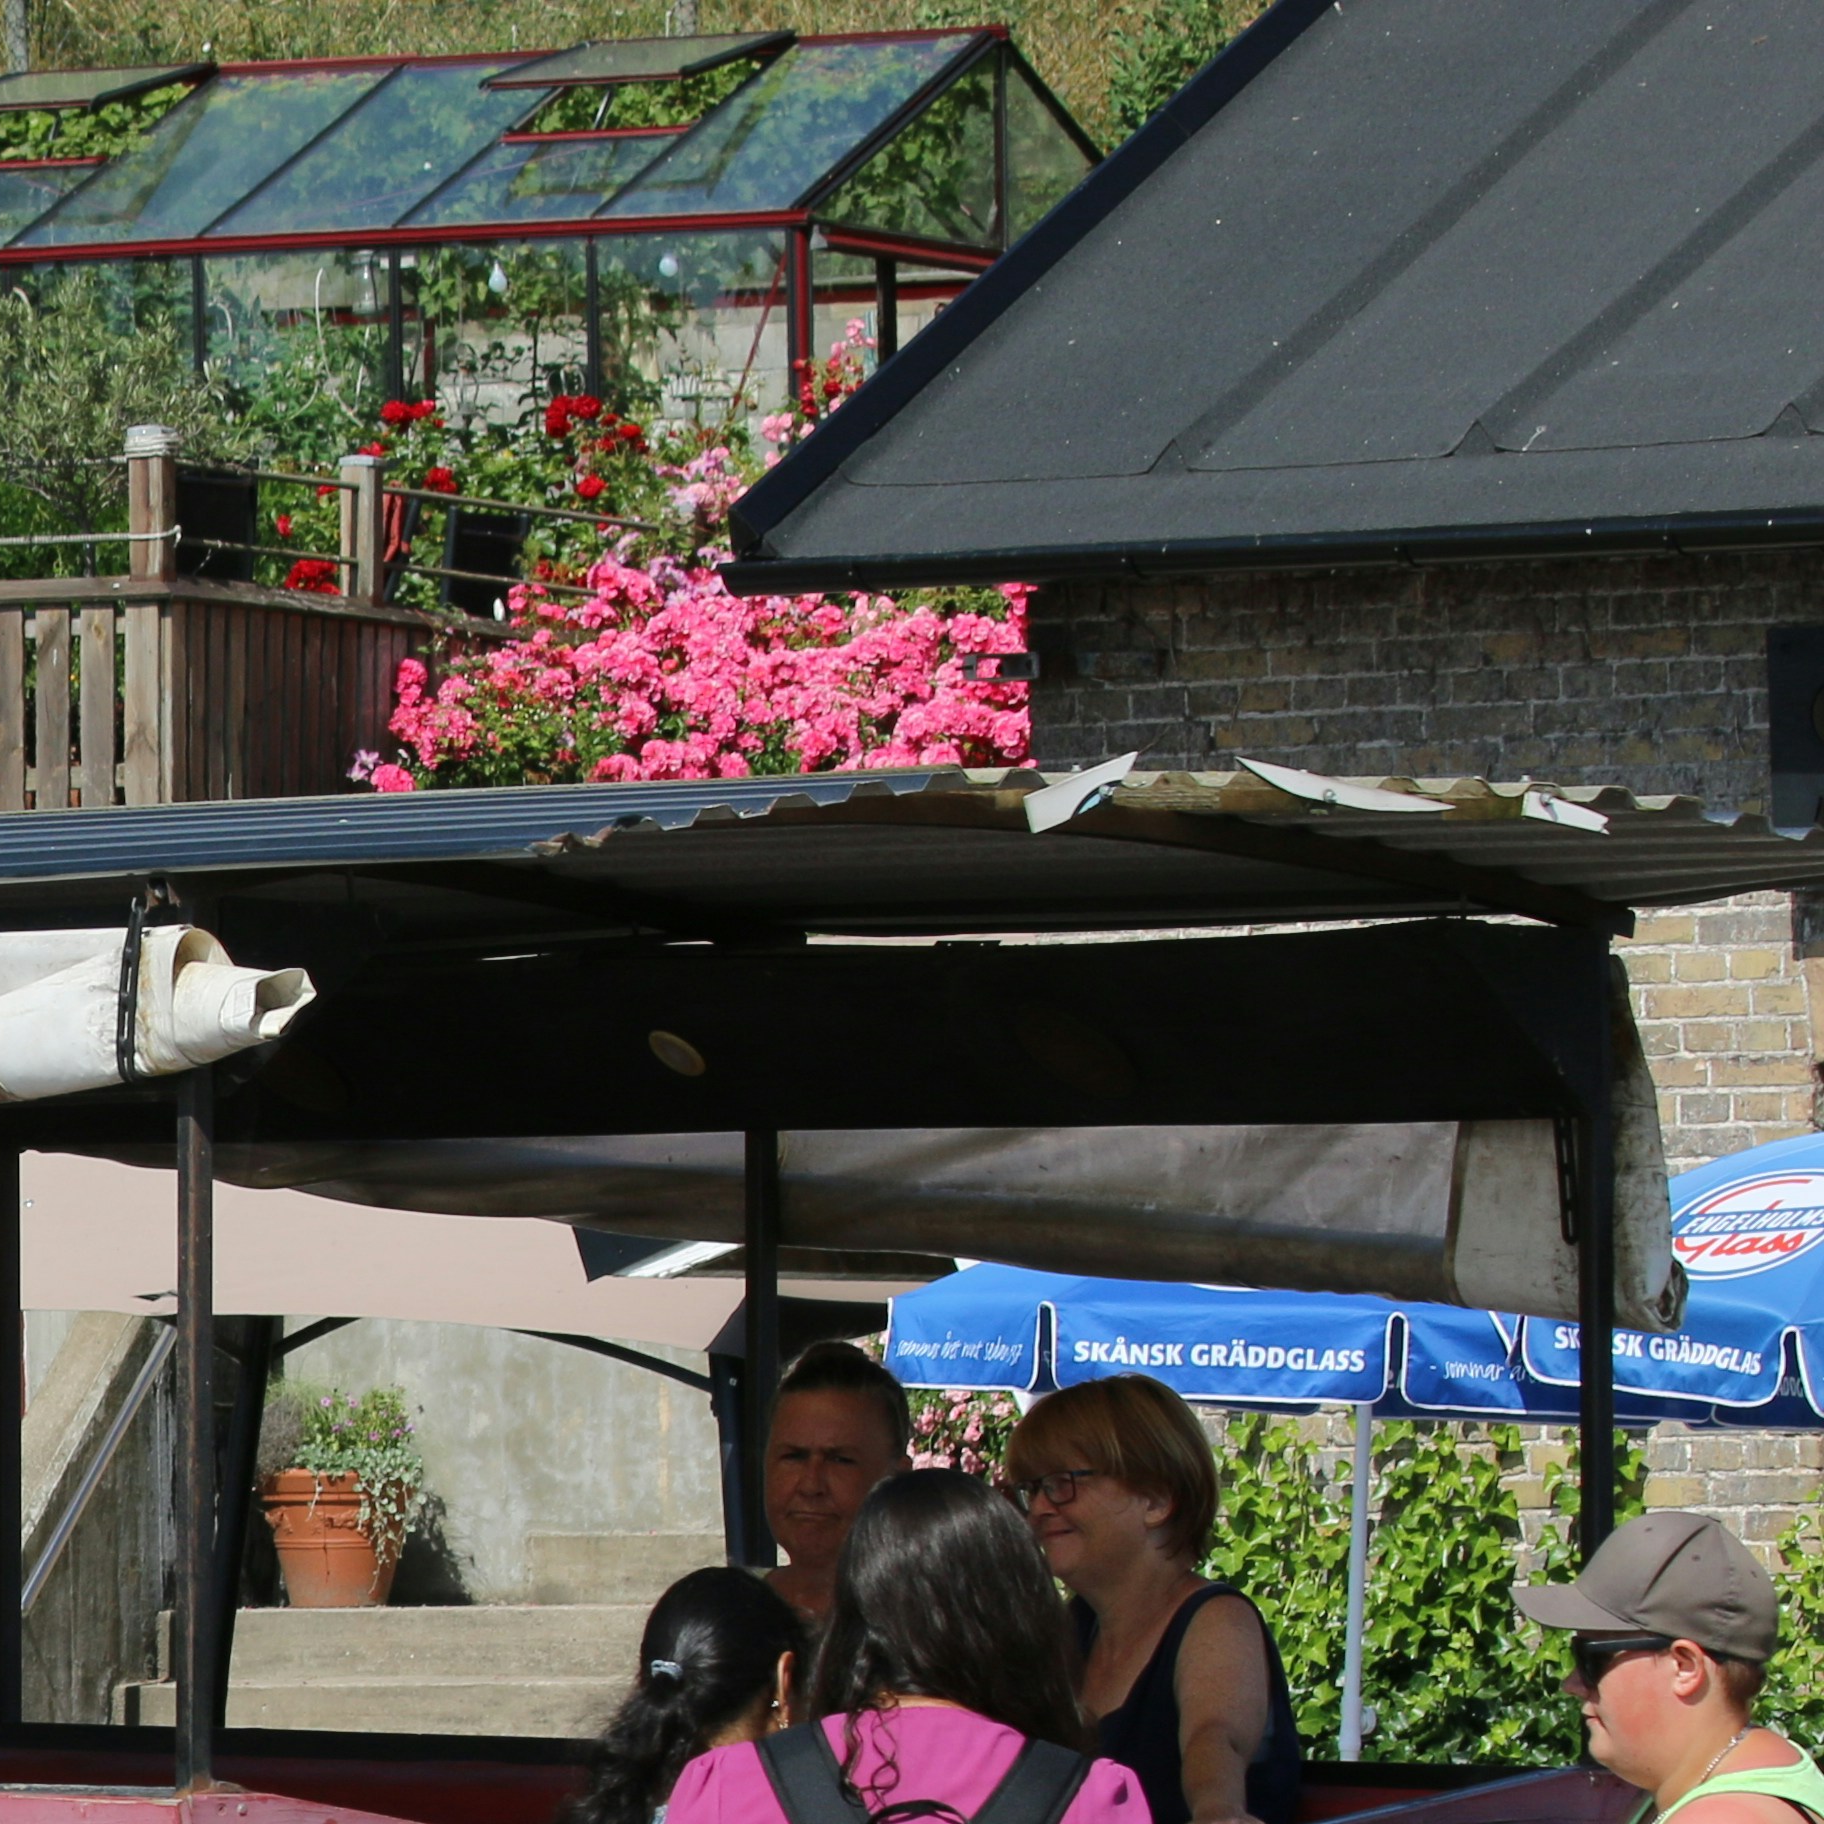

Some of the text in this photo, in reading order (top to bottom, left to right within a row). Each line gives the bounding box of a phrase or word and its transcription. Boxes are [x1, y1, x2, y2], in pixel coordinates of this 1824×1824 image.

[1073, 1336, 1366, 1373] SKÅNSK GRÄDDGLASS
[1554, 1325, 1643, 1358] SKSK
[1443, 1358, 1506, 1382] sommar
